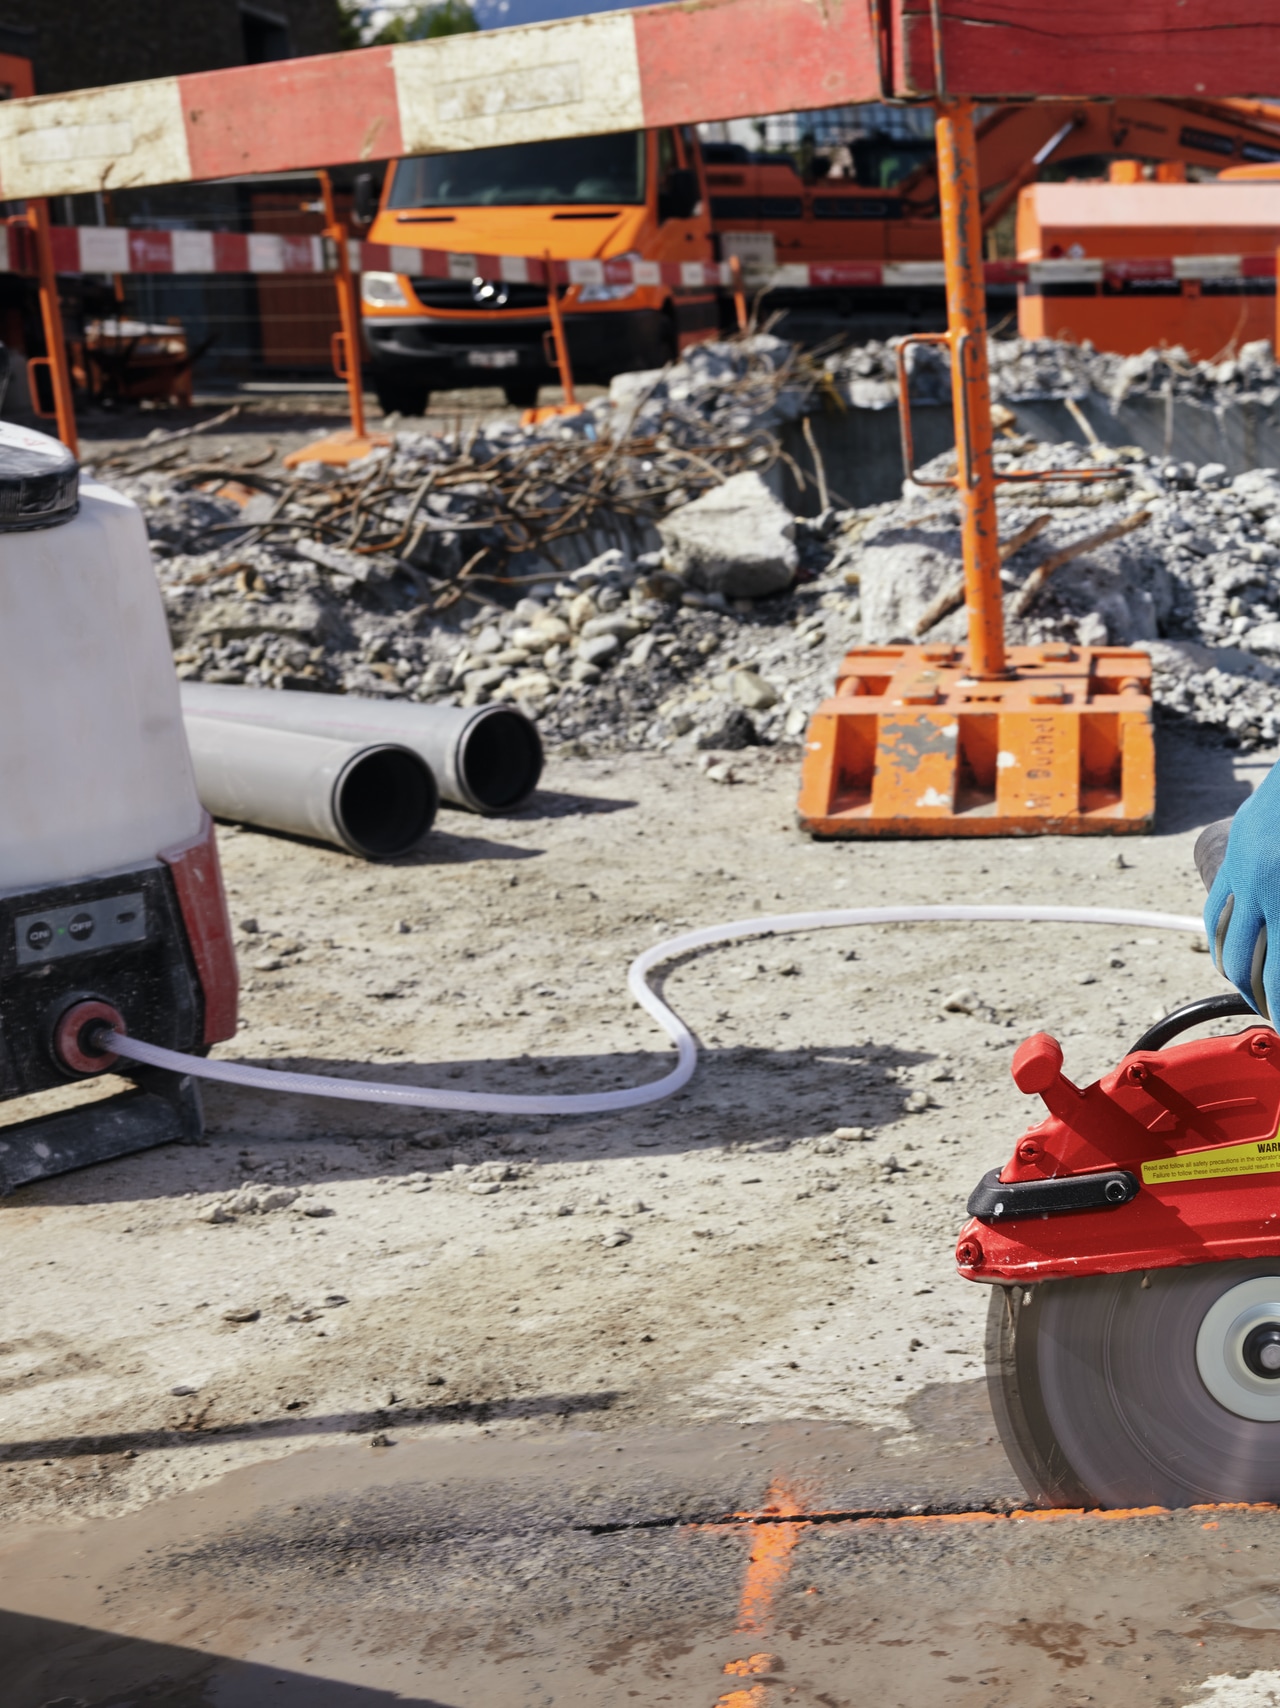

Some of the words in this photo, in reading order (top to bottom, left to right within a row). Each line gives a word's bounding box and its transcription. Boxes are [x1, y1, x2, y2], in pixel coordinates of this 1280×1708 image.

[69, 921, 93, 933] OFF
[30, 930, 50, 941] ON
[1209, 1158, 1239, 1166] precautions
[1152, 1171, 1170, 1179] Failure
[1209, 1166, 1238, 1174] instructions
[1239, 1163, 1254, 1171] could
